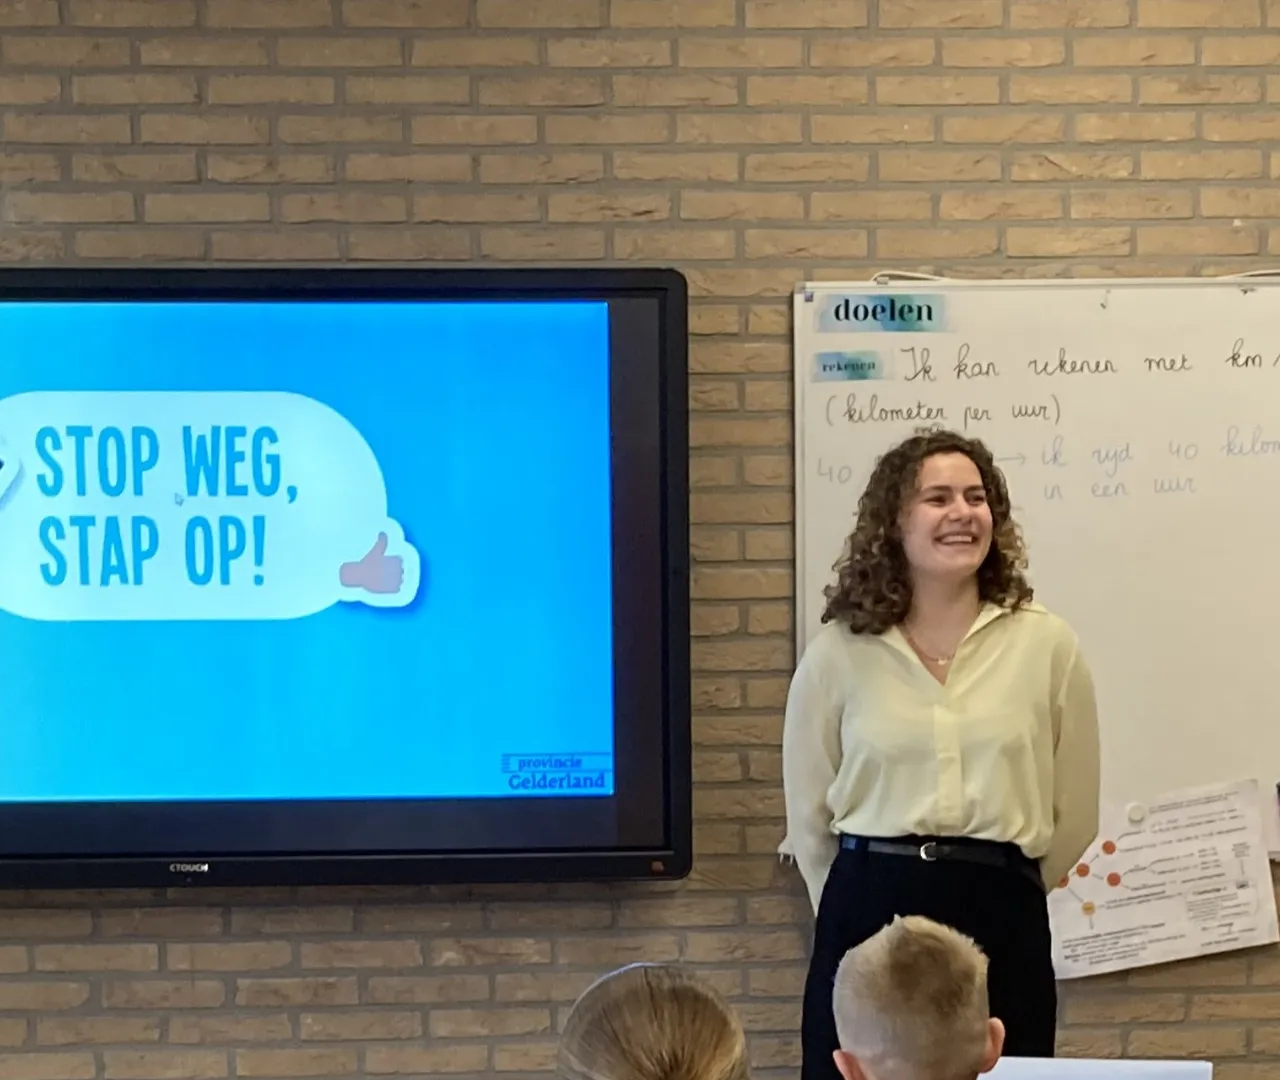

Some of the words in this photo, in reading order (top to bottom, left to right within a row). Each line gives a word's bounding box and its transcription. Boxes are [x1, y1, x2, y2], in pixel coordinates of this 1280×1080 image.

[834, 298, 934, 322] doelen
[821, 360, 876, 373] rekenen
[900, 346, 938, 382] Ik
[953, 343, 1000, 380] kan
[1027, 347, 1118, 376] rekenen
[1143, 353, 1194, 373] met
[963, 404, 993, 431] per
[1011, 393, 1061, 426] uur)
[34, 424, 160, 498] STOP
[181, 424, 299, 505] WEG,
[1040, 434, 1069, 468] ik
[1168, 438, 1199, 461] 40
[816, 457, 852, 484] 40
[1090, 480, 1128, 499] een
[1152, 475, 1198, 494] uur
[38, 515, 160, 588] STAP
[184, 515, 266, 587] OP!
[518, 755, 583, 772] provincie
[508, 772, 606, 790] Gelderland
